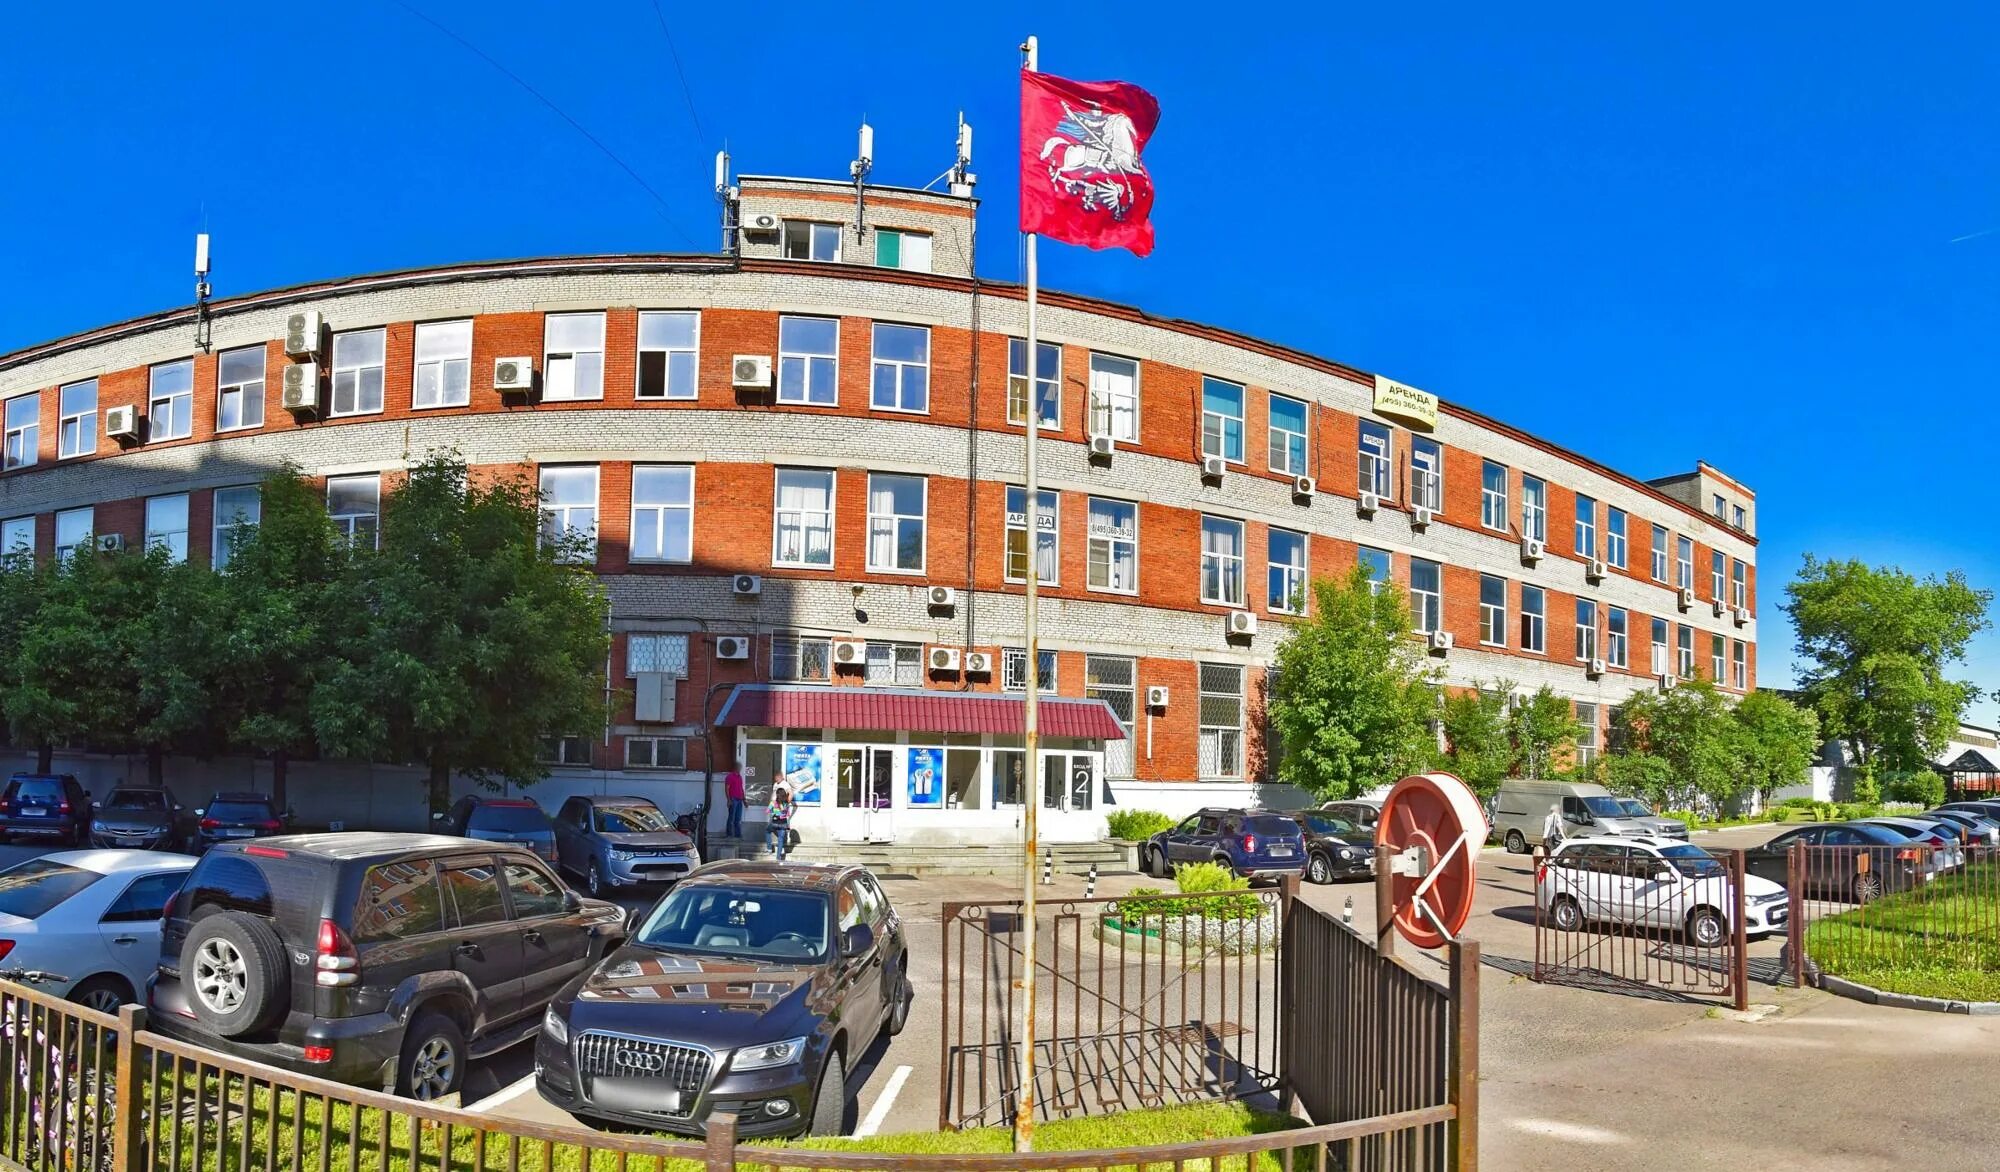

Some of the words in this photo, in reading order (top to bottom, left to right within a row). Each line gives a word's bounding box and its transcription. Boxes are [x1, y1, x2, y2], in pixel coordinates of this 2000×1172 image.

[1382, 397, 1401, 407] (495)
[1389, 385, 1430, 405] АРЕНДА
[1365, 435, 1383, 446] АРЕНДА
[1009, 514, 1051, 526] АРЕДА
[842, 765, 852, 790] 1
[1075, 770, 1089, 793] 2
